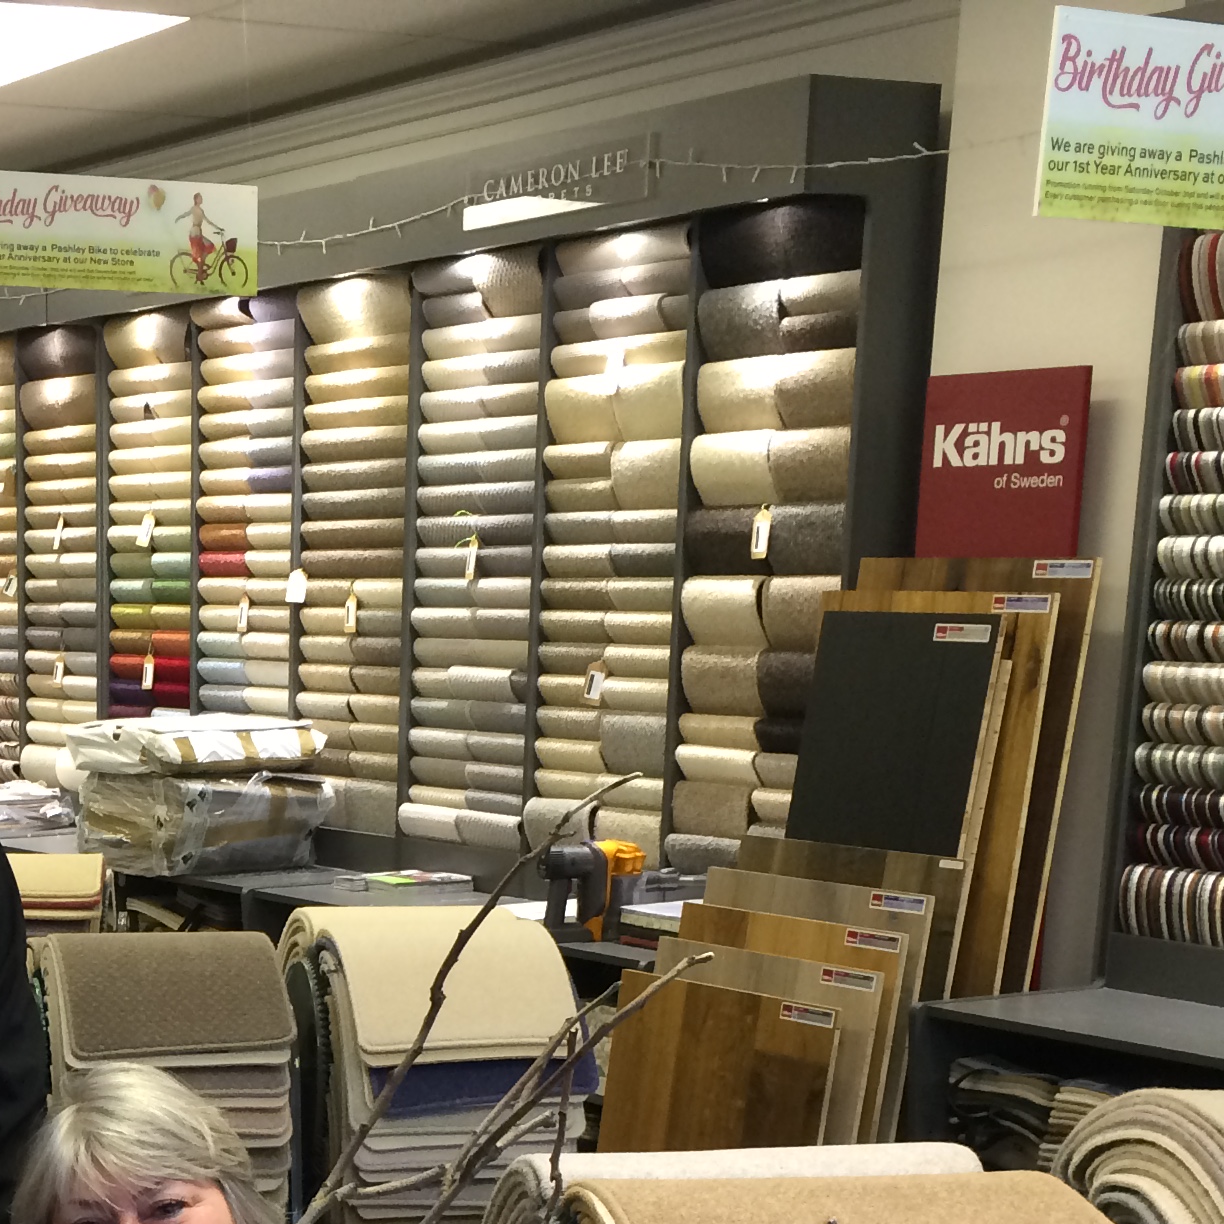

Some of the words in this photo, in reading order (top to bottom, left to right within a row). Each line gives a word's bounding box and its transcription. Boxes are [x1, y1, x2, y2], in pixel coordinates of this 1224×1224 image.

[1054, 33, 1181, 120] Birthday
[1051, 137, 1071, 152] We
[1074, 142, 1095, 154] are
[1098, 141, 1136, 162] giving
[1139, 147, 1172, 164] away
[1175, 151, 1182, 161] a
[483, 159, 580, 201] CAMERON
[592, 149, 628, 178] LEE
[1048, 160, 1070, 171] our
[1073, 160, 1090, 173] 1st
[1094, 160, 1122, 176] Year
[1124, 163, 1200, 186] Anniversary
[1202, 170, 1215, 184] at
[43, 185, 140, 227] Giveaway
[7, 253, 60, 264] Anniversary
[62, 255, 71, 263] at
[89, 256, 109, 265] New
[111, 258, 135, 266] Store
[16, 243, 39, 253] away
[51, 243, 86, 255] Pashley
[88, 245, 108, 255] Bike
[110, 247, 119, 255] to
[120, 248, 160, 257] celebrate
[933, 421, 1066, 468] Kährs
[994, 474, 1009, 489] of
[1010, 473, 1063, 488] Sweden
